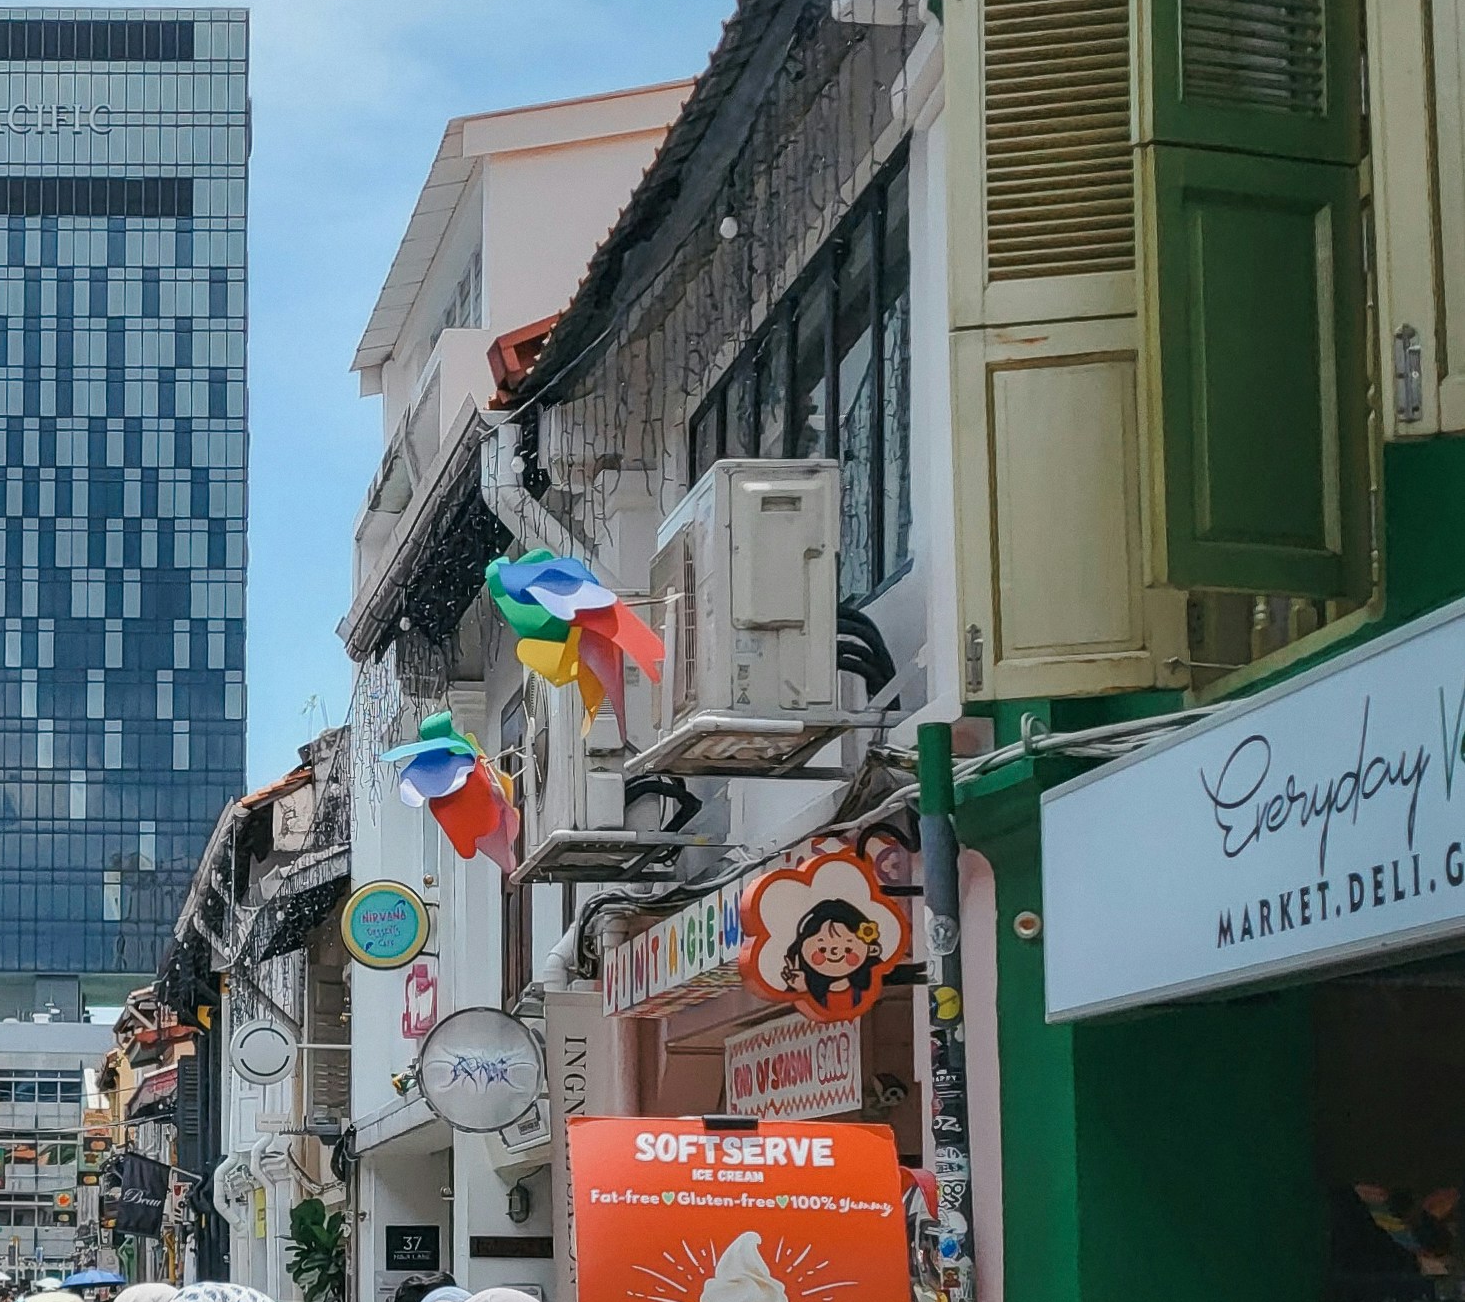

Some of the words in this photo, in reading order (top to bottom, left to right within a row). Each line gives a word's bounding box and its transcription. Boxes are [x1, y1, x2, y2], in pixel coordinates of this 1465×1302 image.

[1201, 695, 1431, 876] Everyday
[756, 1057, 770, 1095] OF
[635, 1132, 835, 1167] SOFTSERVE
[692, 1169, 714, 1182] ICE
[717, 1169, 764, 1183] CREAM
[590, 1189, 660, 1205] Fat-free
[677, 1191, 776, 1209] Gluten-free
[790, 1196, 837, 1210] 100%
[402, 1236, 422, 1251] 37
